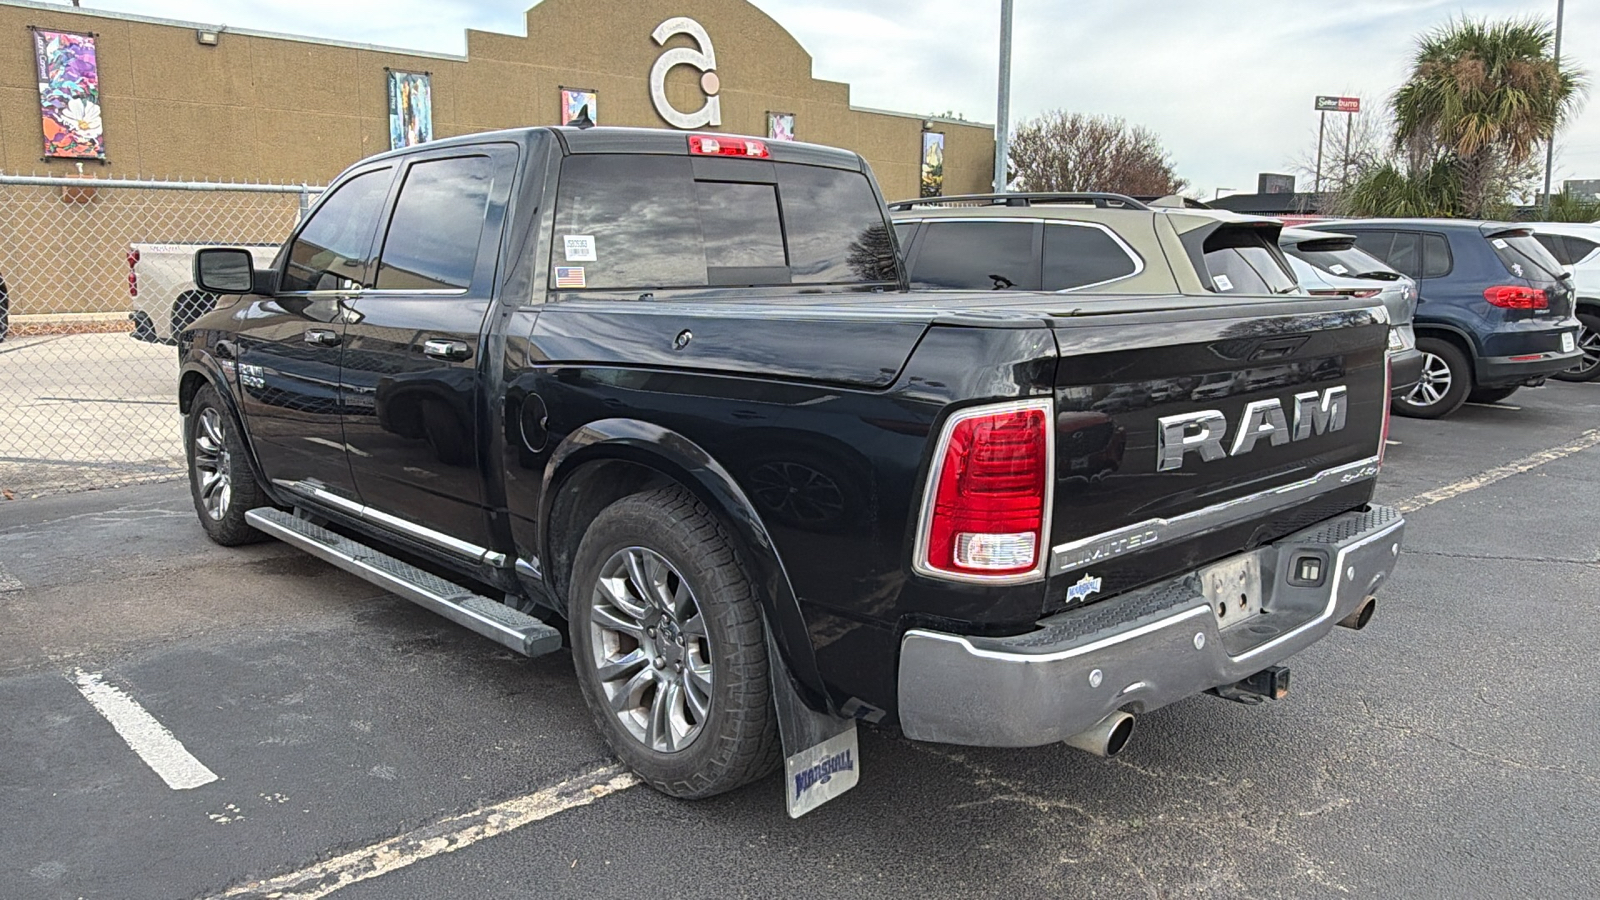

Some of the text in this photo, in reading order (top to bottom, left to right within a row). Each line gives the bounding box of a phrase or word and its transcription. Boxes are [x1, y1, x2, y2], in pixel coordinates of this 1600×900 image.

[1338, 98, 1358, 108] burro
[1157, 385, 1347, 472] RAM
[1060, 531, 1158, 569] LIMITED
[795, 748, 854, 801] MARSHALL
